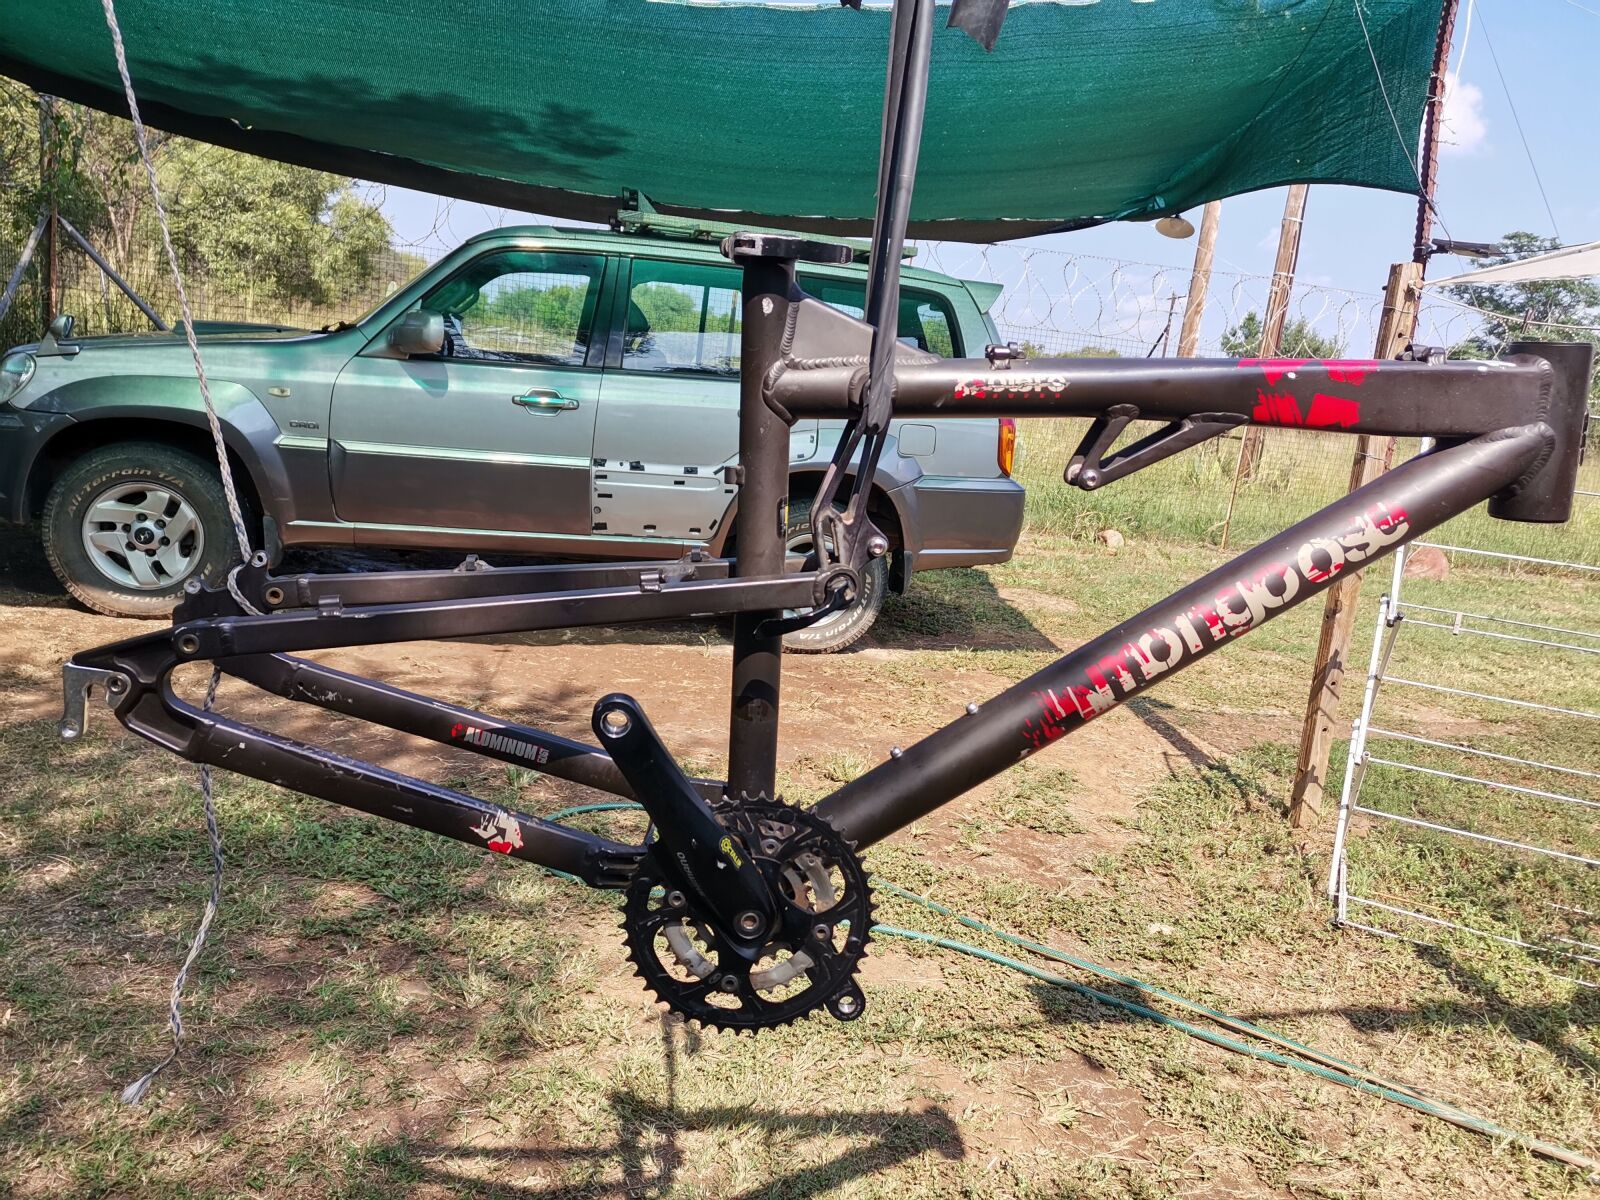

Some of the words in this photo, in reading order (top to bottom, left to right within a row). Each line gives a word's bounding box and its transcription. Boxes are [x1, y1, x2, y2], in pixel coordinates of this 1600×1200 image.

[68, 467, 152, 517] All-Terrain
[158, 471, 184, 488] T/A
[825, 573, 872, 637] All-Terrain
